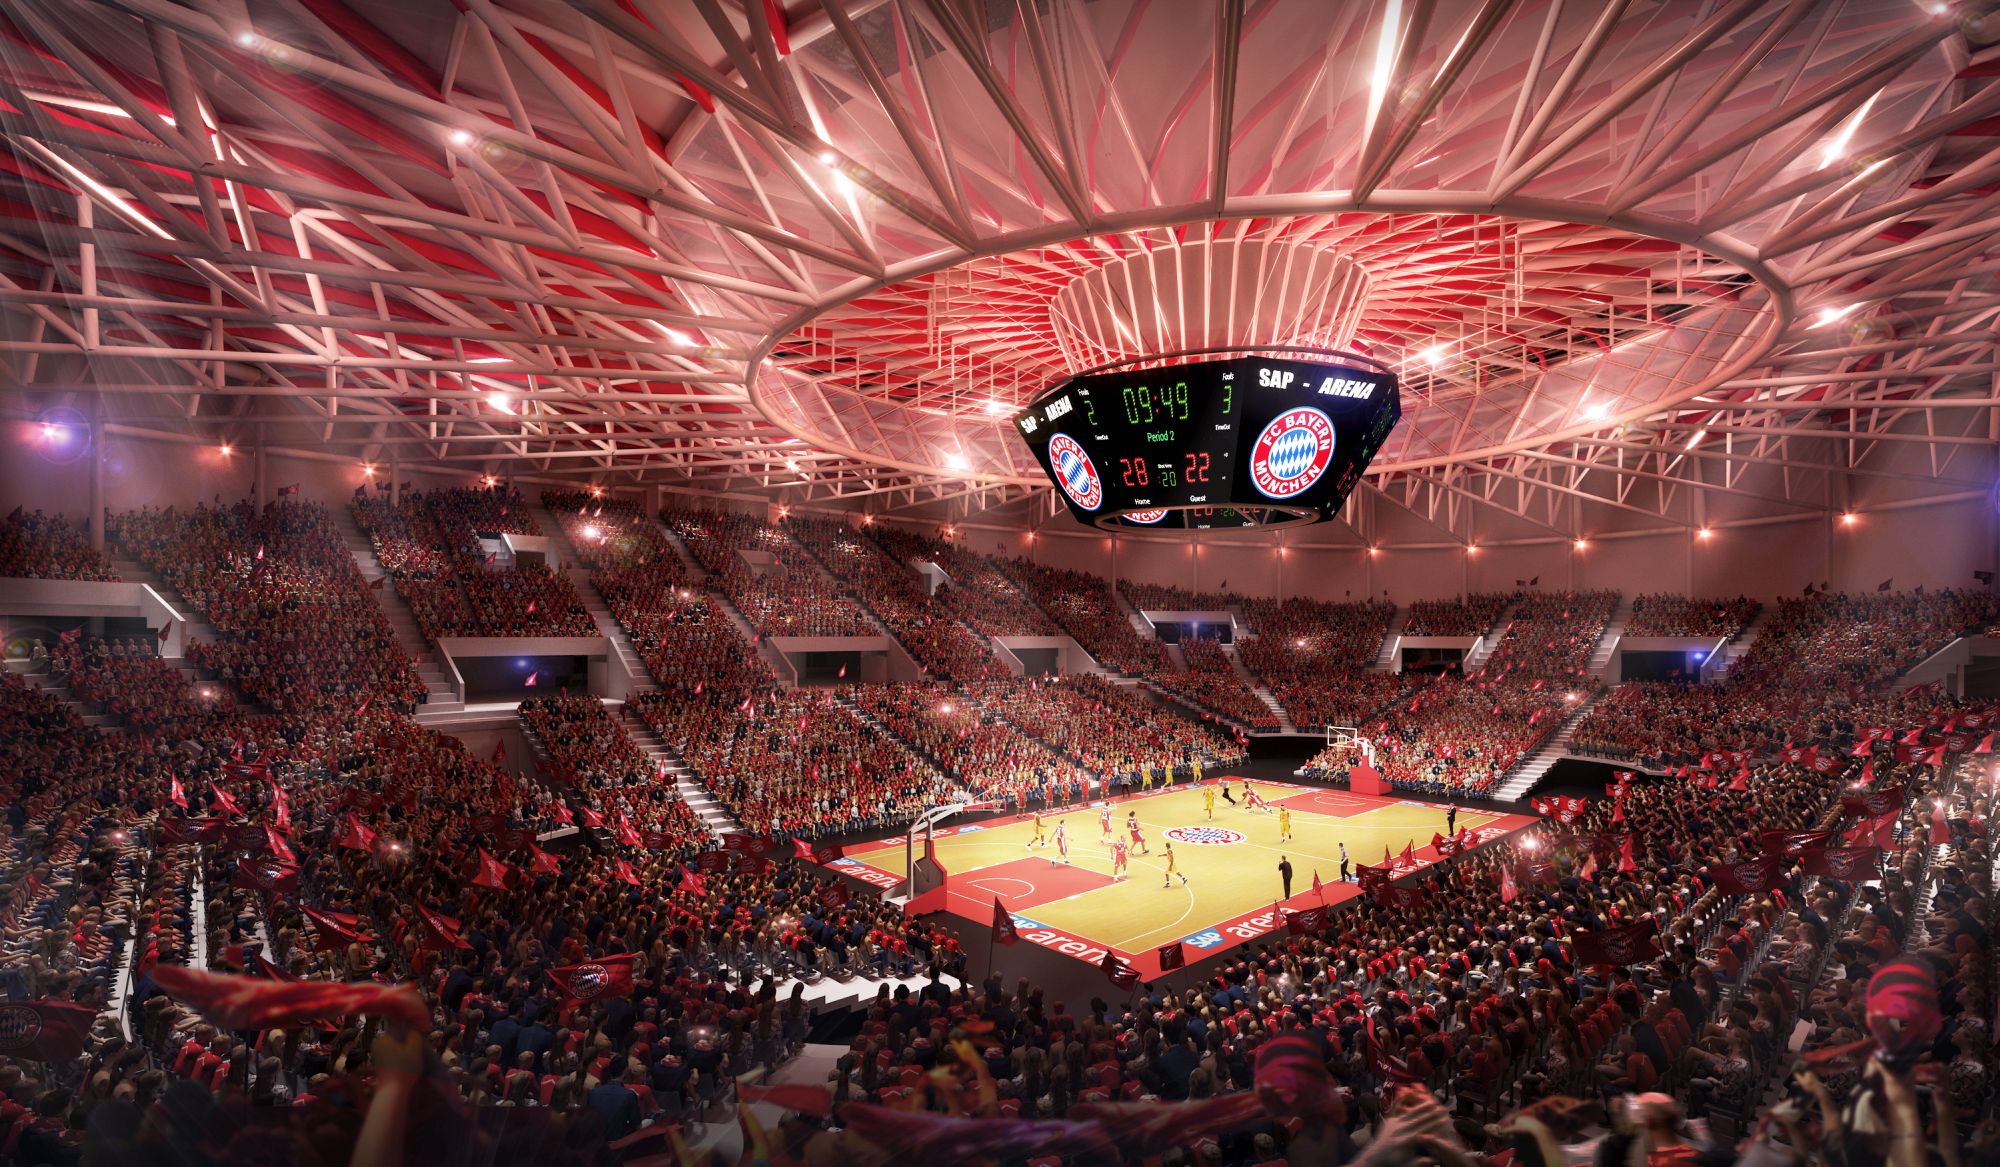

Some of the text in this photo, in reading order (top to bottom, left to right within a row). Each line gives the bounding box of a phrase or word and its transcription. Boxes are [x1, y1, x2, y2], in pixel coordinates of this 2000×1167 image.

[1259, 368, 1294, 389] SAP
[1318, 377, 1376, 399] ARENA
[1020, 415, 1038, 434] SAP
[1045, 395, 1073, 422] ARENA
[1084, 400, 1098, 426] 2
[1123, 382, 1189, 424] 09:49
[1222, 385, 1232, 414] 3
[1147, 430, 1175, 442] Period 2
[1261, 413, 1330, 451] FC BAYERN
[1051, 437, 1087, 473] FC BAYERN
[1185, 452, 1210, 482] 22
[1120, 457, 1149, 487] 28
[1255, 459, 1321, 494] MÜNCHEN
[1189, 494, 1207, 503] Guest
[840, 865, 900, 888] aren
[1185, 932, 1222, 948] SAP
